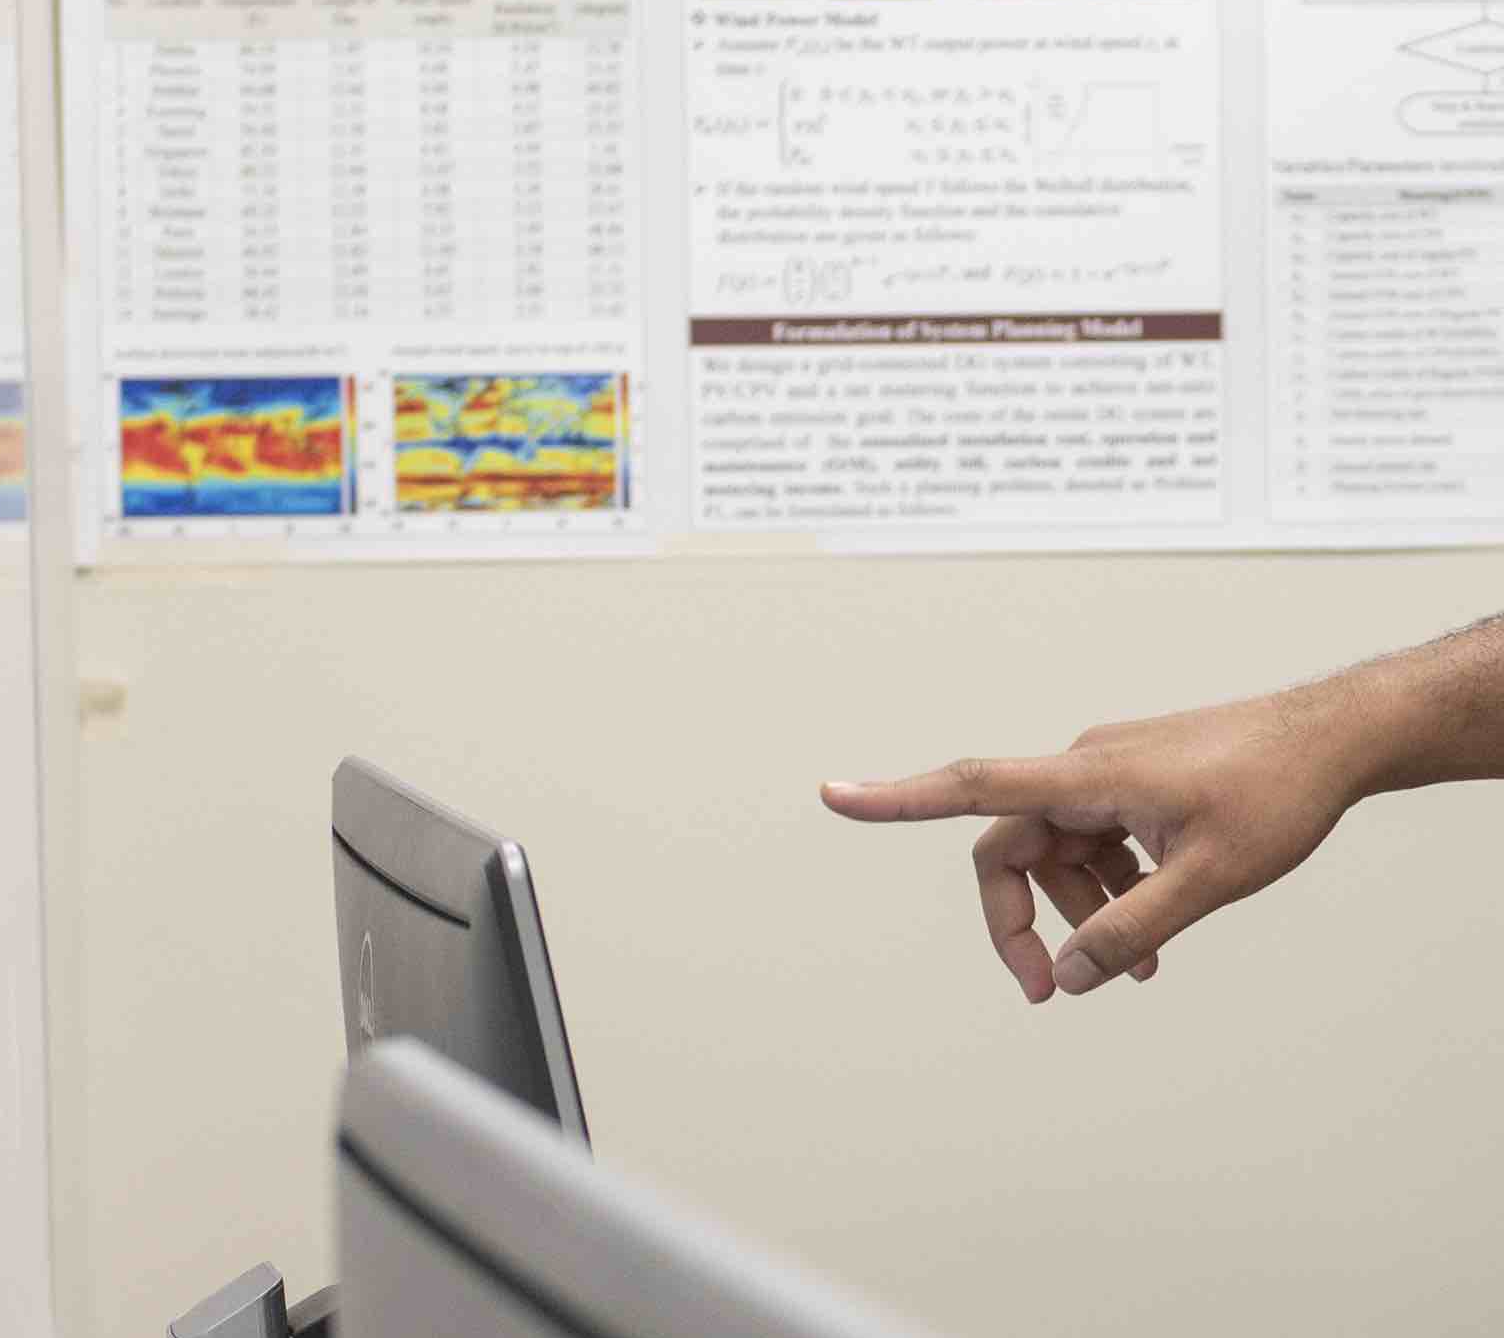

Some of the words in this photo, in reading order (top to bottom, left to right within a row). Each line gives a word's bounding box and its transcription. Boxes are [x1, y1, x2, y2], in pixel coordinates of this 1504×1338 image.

[772, 319, 891, 343] Formulation
[897, 319, 917, 342] of
[921, 319, 987, 341] System
[992, 318, 1077, 341] Planning
[1081, 318, 1143, 340] Model
